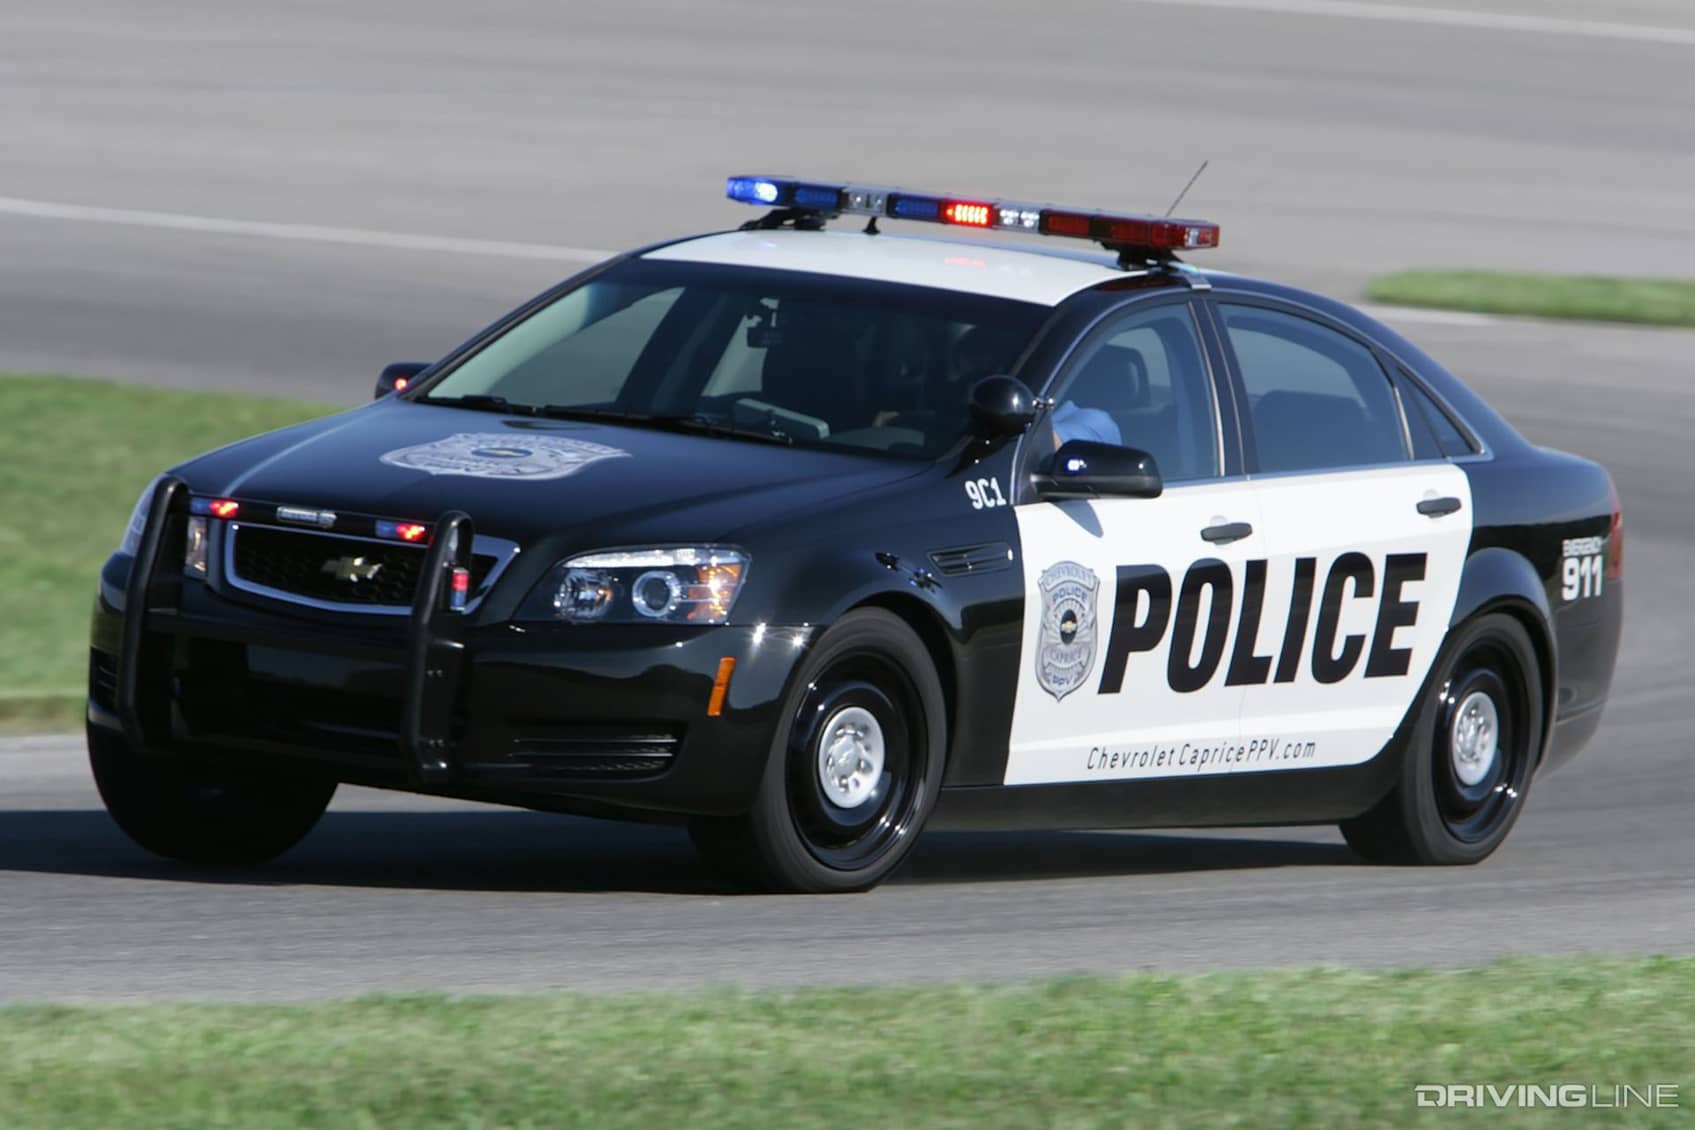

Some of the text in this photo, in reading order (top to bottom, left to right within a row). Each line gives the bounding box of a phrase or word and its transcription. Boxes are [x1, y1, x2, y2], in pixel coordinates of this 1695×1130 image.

[965, 477, 1007, 510] 9C1
[1052, 586, 1088, 602] POLICE
[1562, 554, 1603, 601] 911
[1097, 551, 1428, 695] POLICE
